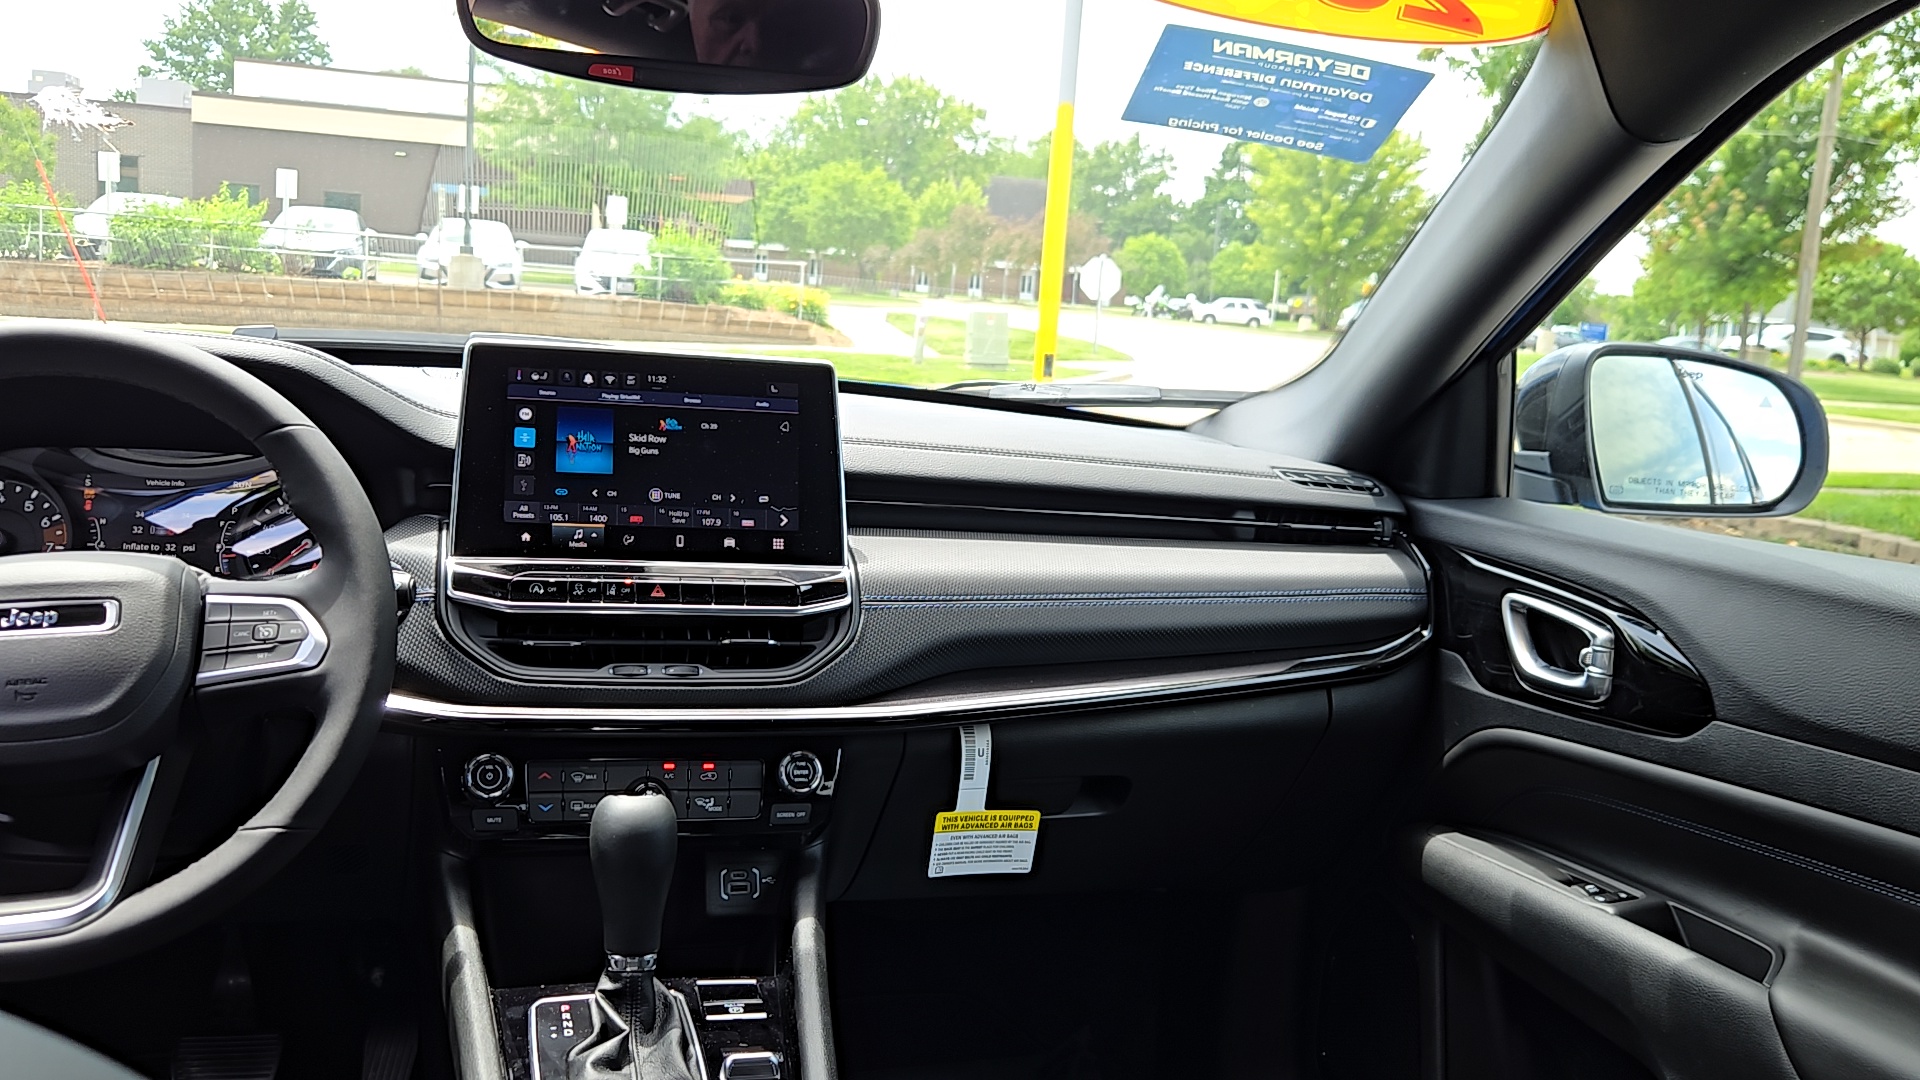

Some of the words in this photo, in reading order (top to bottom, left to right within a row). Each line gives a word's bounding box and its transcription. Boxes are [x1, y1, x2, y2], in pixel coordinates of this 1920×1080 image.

[648, 375, 667, 383] 11:32
[629, 434, 648, 442] Skid
[648, 435, 667, 443] Row
[629, 447, 640, 455] Big
[640, 447, 659, 455] Guns
[146, 479, 170, 487] Vehicle
[1628, 477, 1661, 485] OBJECTS
[1666, 478, 1673, 486] IN
[1655, 487, 1676, 495] THAN
[664, 492, 681, 500] TUNE
[24, 500, 34, 512] 5
[41, 517, 50, 528] 6
[702, 518, 721, 526] 107.9
[132, 525, 143, 534] 32
[46, 543, 54, 553] 7
[123, 543, 149, 551] Inflate
[182, 543, 196, 552] psi
[1, 608, 59, 628] Jeep
[977, 747, 985, 757] U
